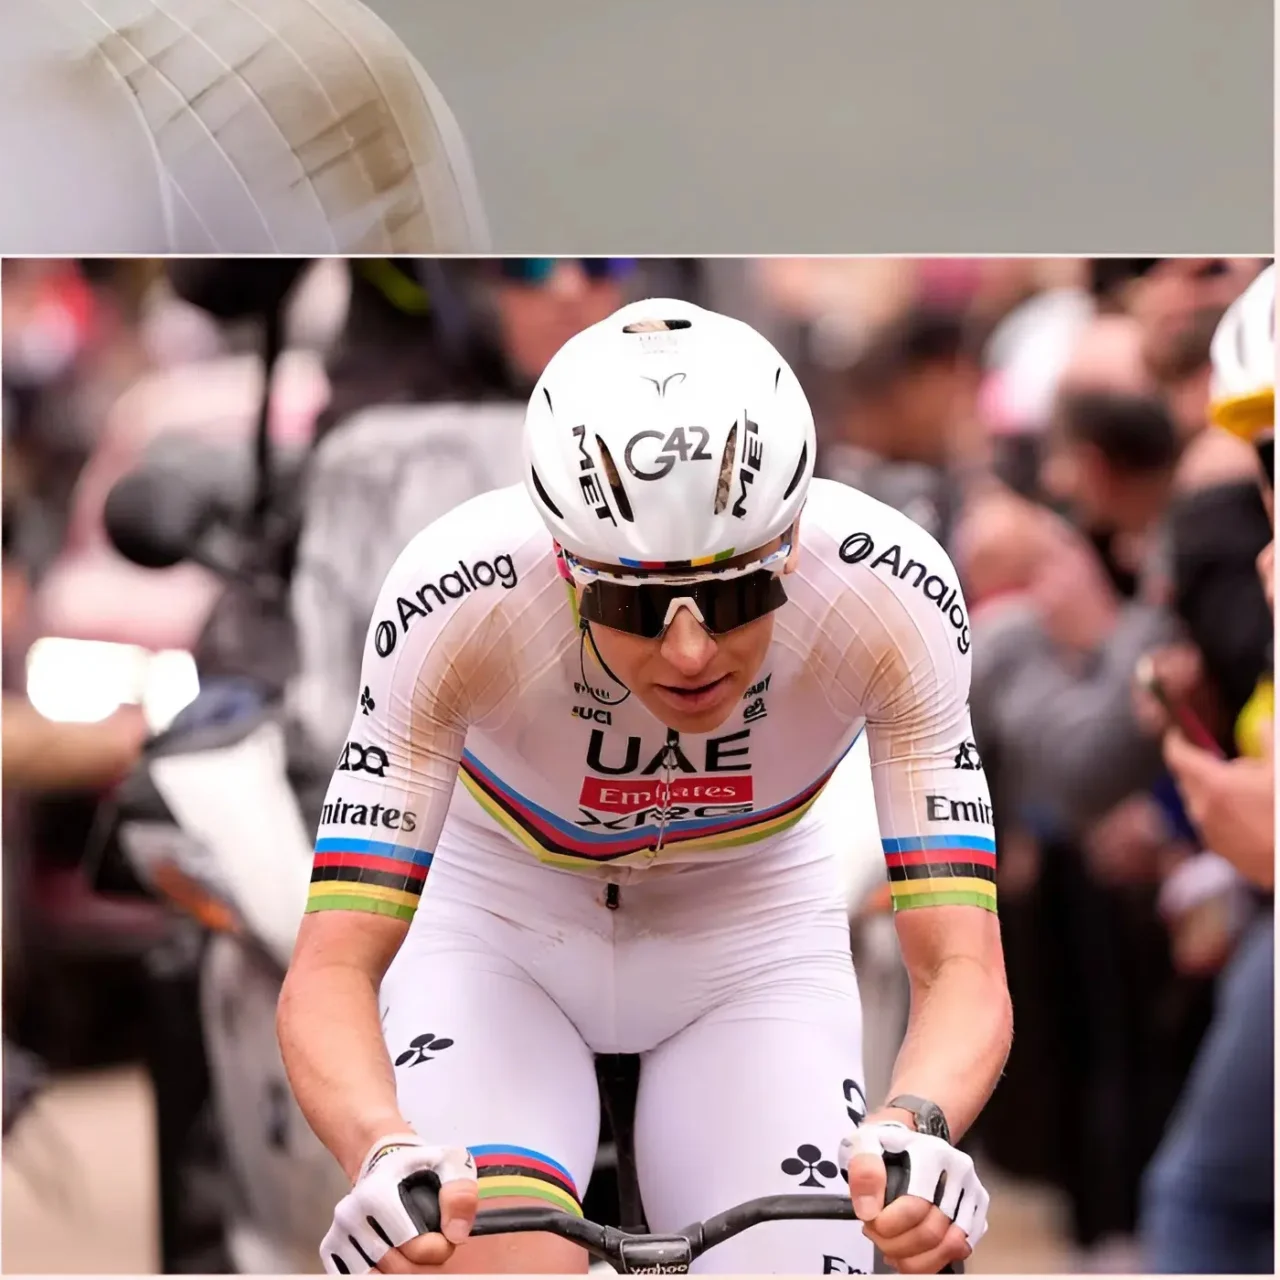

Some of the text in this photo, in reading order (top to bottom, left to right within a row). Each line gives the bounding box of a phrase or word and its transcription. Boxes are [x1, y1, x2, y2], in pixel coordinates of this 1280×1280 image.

[572, 424, 618, 528] MET
[624, 426, 712, 482] G42
[732, 408, 763, 520] MET
[397, 553, 518, 634] Analog
[870, 544, 970, 655] Analog
[579, 706, 612, 725] UCI
[586, 728, 753, 775] UAE
